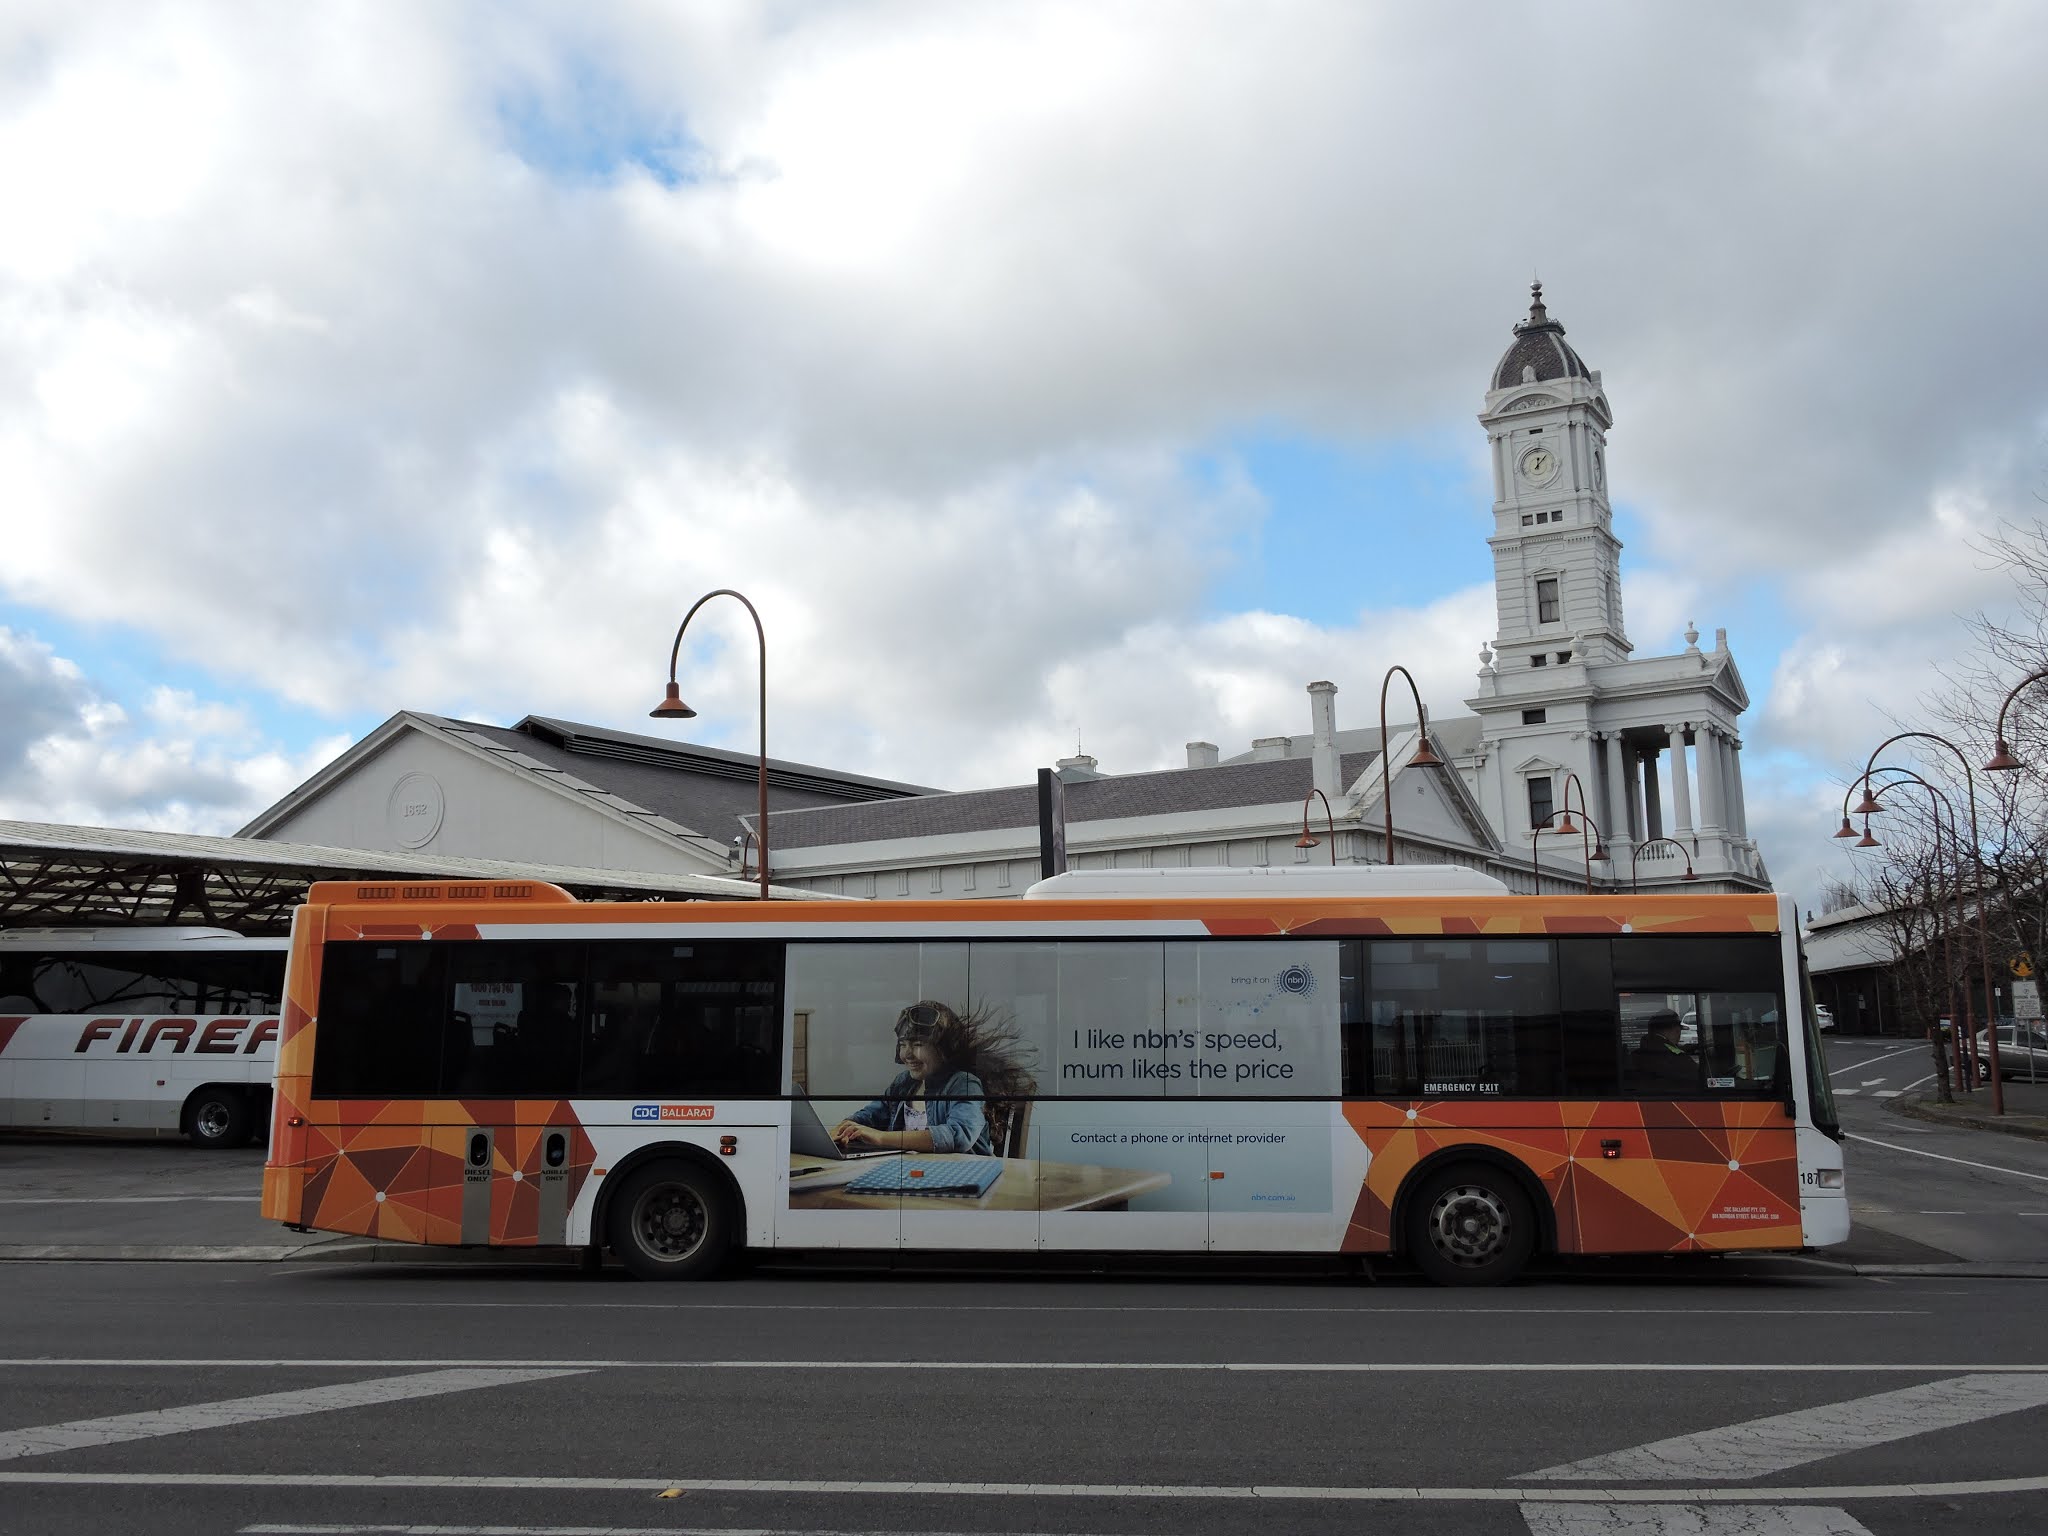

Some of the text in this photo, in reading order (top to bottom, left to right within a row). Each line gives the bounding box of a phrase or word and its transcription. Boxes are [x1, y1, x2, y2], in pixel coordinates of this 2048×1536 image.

[402, 803, 428, 818] 1862
[1231, 976, 1251, 985] bring
[1252, 976, 1258, 984] it
[1287, 976, 1303, 984] nbn
[1073, 1029, 1078, 1049] I
[1087, 1028, 1125, 1049] like
[1204, 1028, 1283, 1053] speed,
[1063, 1058, 1294, 1083] mum likes the price
[1423, 1083, 1500, 1092] EMERGENCY EXIT
[633, 1107, 713, 1118] CDC BALLARAT
[1070, 1132, 1286, 1145] Contact a phone or internet provider
[1251, 1193, 1296, 1201] nbn.com.au
